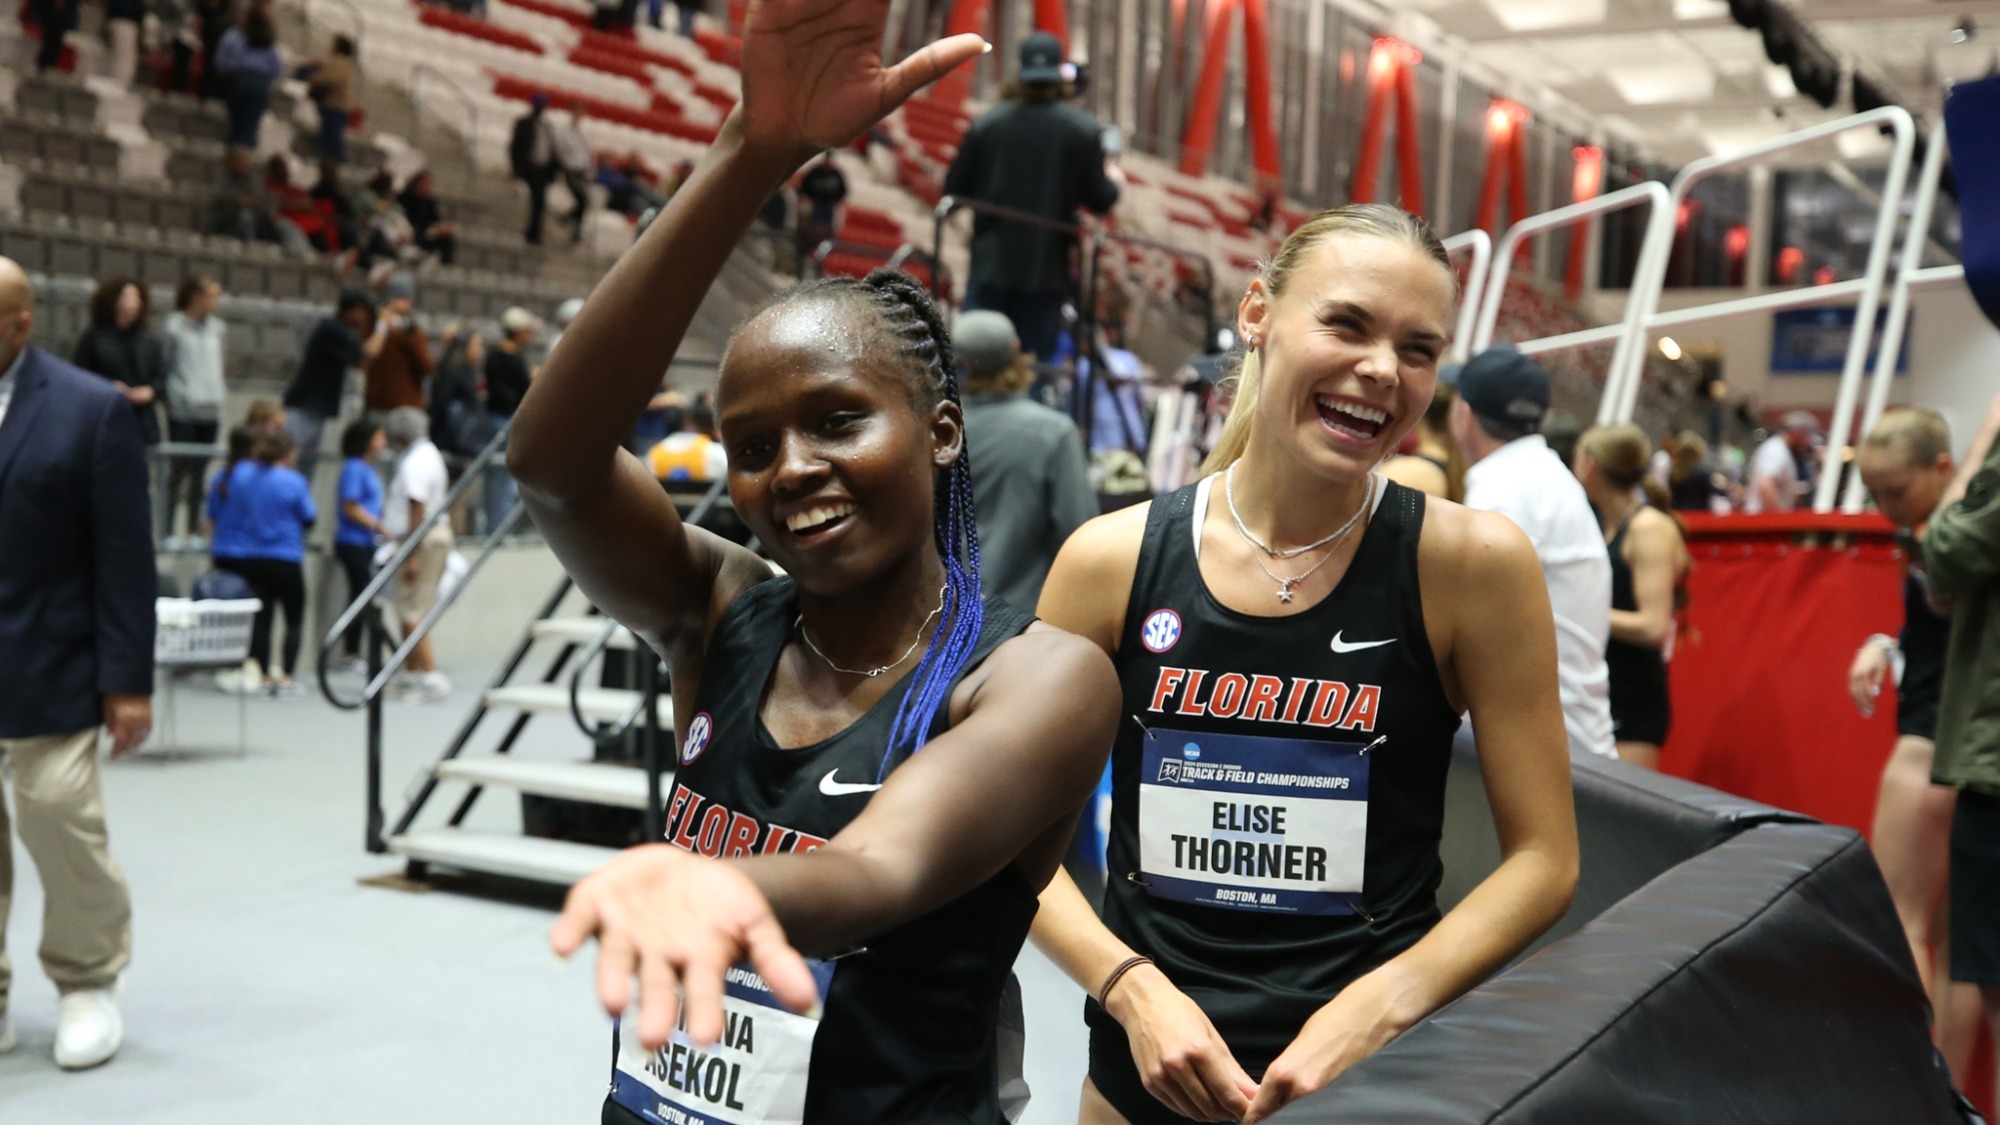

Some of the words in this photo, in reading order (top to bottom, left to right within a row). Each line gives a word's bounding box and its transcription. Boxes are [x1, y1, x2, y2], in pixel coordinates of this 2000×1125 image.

[1145, 611, 1180, 650] SEC
[1147, 666, 1382, 732] FLORIDA
[683, 715, 709, 761] SEC
[1182, 766, 1215, 780] TRACK
[1215, 769, 1225, 781] &
[1225, 770, 1256, 784] FIELD
[1256, 775, 1350, 790] CHAMPIONSHIPS
[664, 783, 829, 859] FLORI
[1212, 801, 1287, 835] ELISE
[1171, 834, 1327, 881] THORNER
[1215, 888, 1258, 904] BOSTON,
[1260, 893, 1277, 905] MA
